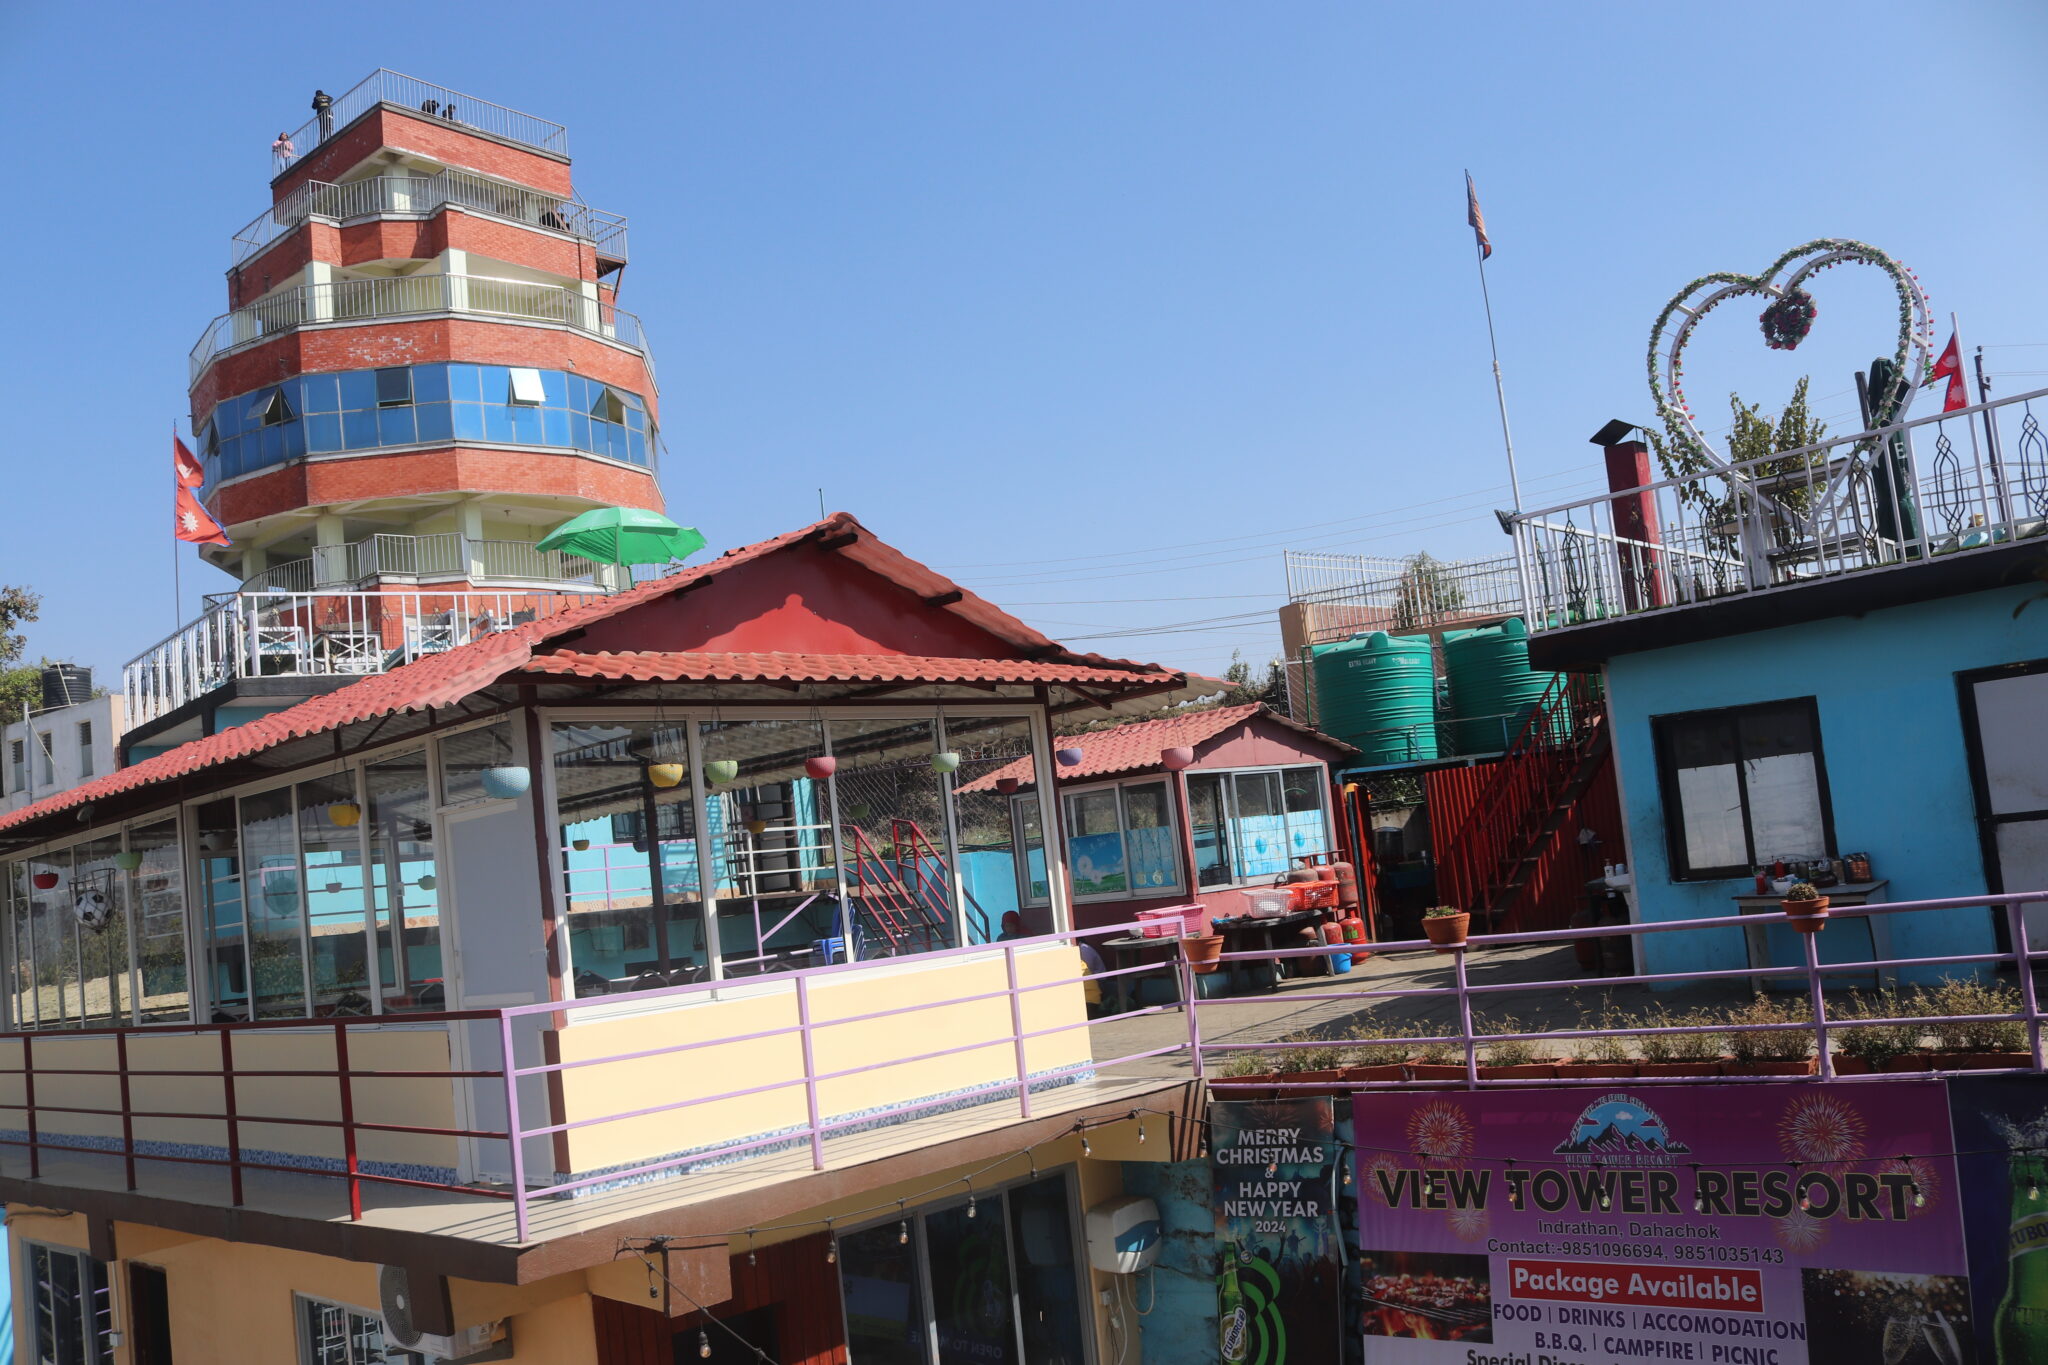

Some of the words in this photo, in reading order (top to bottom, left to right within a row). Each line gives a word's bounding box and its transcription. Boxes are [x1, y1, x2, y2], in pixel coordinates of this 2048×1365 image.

[1238, 1128, 1301, 1146] MERRY
[1216, 1146, 1324, 1164] CHRISTMAS
[1264, 1167, 1274, 1179] &
[1239, 1181, 1302, 1198] HAPPY
[1376, 1169, 1491, 1210] VIEW
[1505, 1169, 1684, 1215] TOWER
[1696, 1170, 1913, 1221] RESORT
[1224, 1200, 1266, 1217] NEW
[1269, 1200, 1319, 1217] YEAR
[1255, 1220, 1287, 1233] 2024
[1538, 1219, 1624, 1237] Indrathan,
[1629, 1222, 1721, 1240] Dahachok
[1674, 1244, 1785, 1264] 9851035143
[1514, 1267, 1620, 1299] Package
[1627, 1272, 1758, 1302] Available
[1493, 1303, 1542, 1322] FOOD
[1558, 1307, 1626, 1328] DRINKS
[1642, 1312, 1806, 1341] ACCOMODATION
[1223, 1319, 1244, 1356] TUBORG
[1535, 1332, 1587, 1353] B.B.Q.
[1603, 1336, 1694, 1360] CAMPFIRE
[1711, 1344, 1779, 1365] PICNIC
